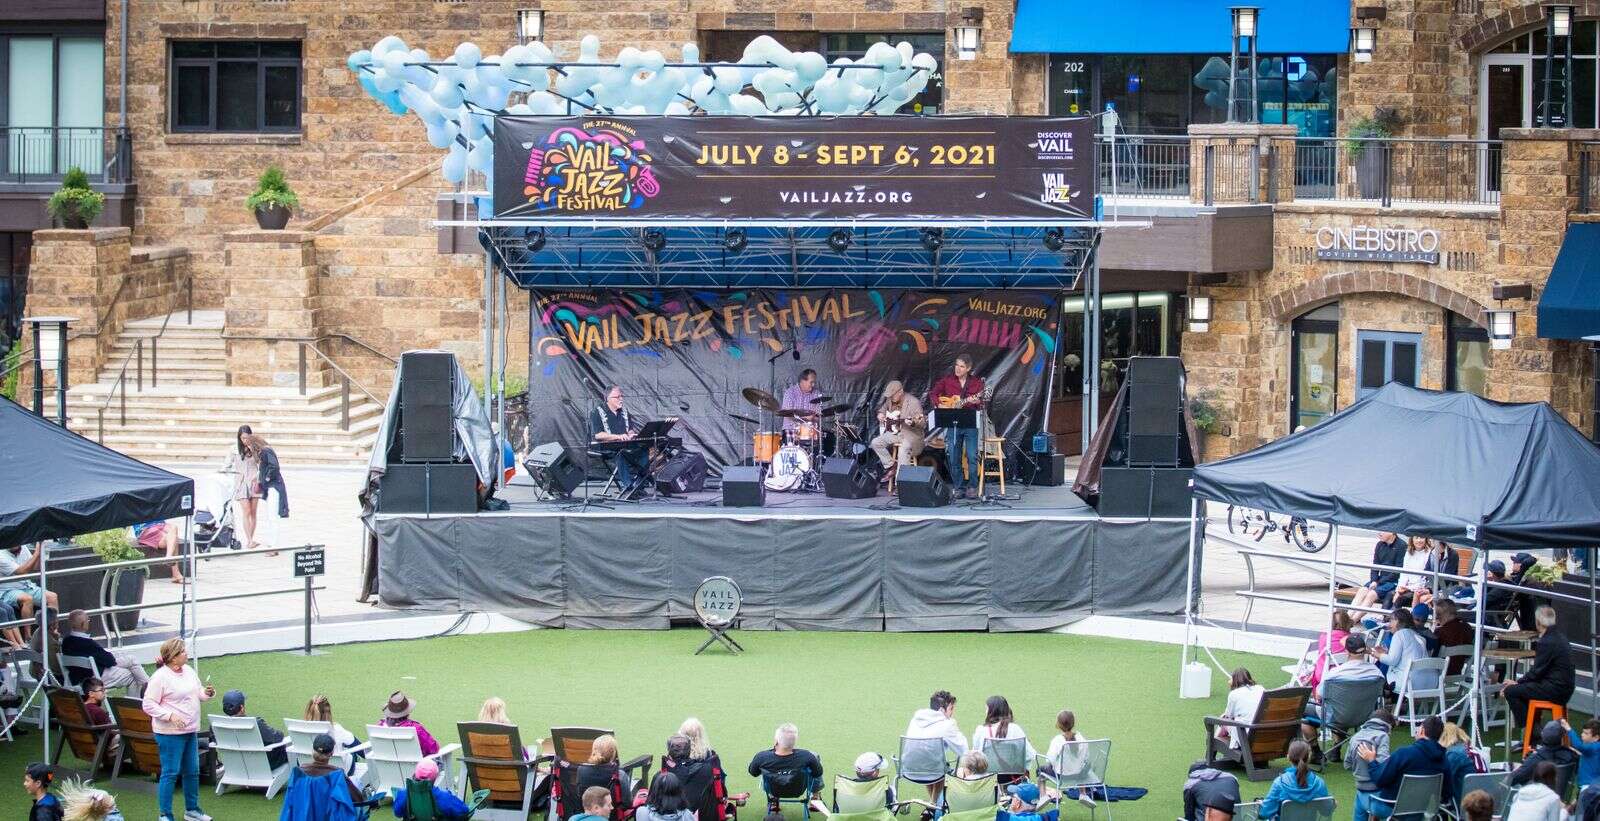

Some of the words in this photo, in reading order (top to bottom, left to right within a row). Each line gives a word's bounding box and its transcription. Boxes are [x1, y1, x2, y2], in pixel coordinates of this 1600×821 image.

[1064, 62, 1085, 73] 202
[583, 121, 593, 129] THE
[611, 122, 636, 136] ANNUAL
[1038, 139, 1073, 152] VAIL
[566, 142, 618, 172] VAIL
[696, 145, 763, 165] JULY
[773, 144, 789, 165] 8
[816, 145, 884, 165] SEPT
[894, 144, 920, 167] 6,
[930, 145, 995, 165] 2021
[559, 168, 625, 199] JAZZ
[1042, 173, 1070, 189] VAIL
[557, 194, 627, 211] FESTIVAL
[779, 191, 913, 203] VAILJAZZ.ORG
[1040, 187, 1070, 203] JAZZ
[569, 292, 597, 303] ANNUAL
[565, 313, 632, 354] VAIL
[635, 309, 716, 347] JAZZ
[723, 293, 865, 335] FESTIVAL
[702, 590, 733, 599] VAIL
[702, 601, 734, 610] JAZZ
